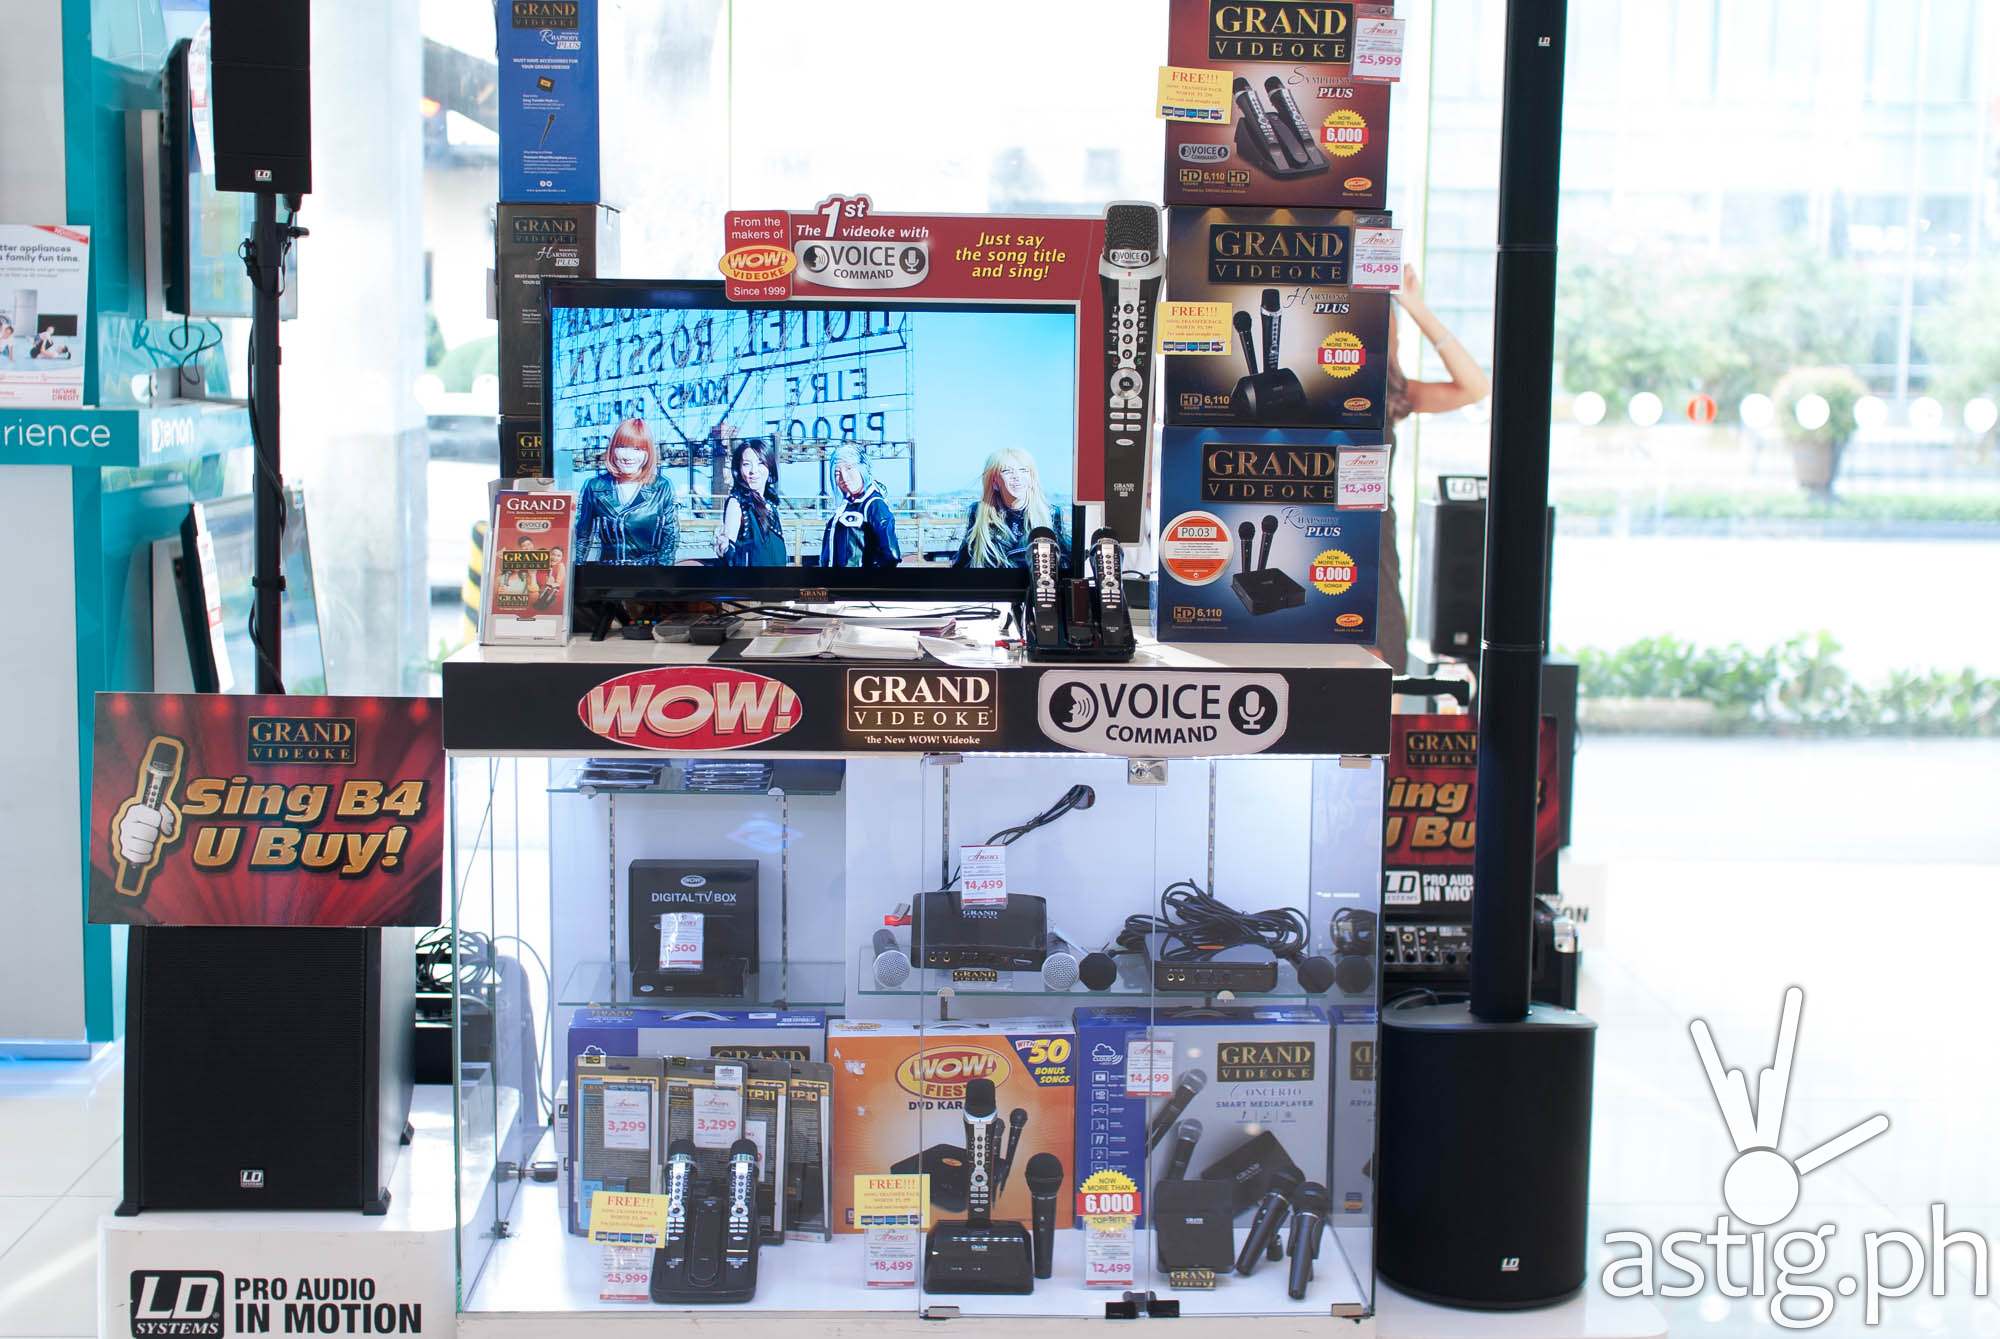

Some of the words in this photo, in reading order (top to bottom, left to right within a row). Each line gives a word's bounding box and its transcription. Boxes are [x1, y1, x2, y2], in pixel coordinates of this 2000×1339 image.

[514, 3, 577, 16] GRAND
[1216, 6, 1347, 34] GRAND
[1216, 41, 1345, 57] VIDEOKE
[1360, 55, 1401, 66] 25,999
[1172, 72, 1218, 83] FREE!!!
[1318, 87, 1354, 98] PLUS
[1326, 128, 1363, 142] 6,000
[1191, 146, 1217, 155] VOICE
[1181, 170, 1200, 181] HD
[1203, 172, 1225, 182] 6,110
[1229, 171, 1248, 182] HD
[734, 218, 760, 227] From
[764, 218, 781, 227] the
[821, 200, 866, 238] 1st
[514, 219, 576, 232] GRAND
[796, 224, 821, 236] The
[900, 225, 929, 238] with
[732, 231, 770, 239] makers
[774, 230, 783, 239] of
[842, 226, 895, 238] videoke
[976, 232, 1011, 247] Just
[1017, 234, 1045, 249] say
[1216, 231, 1343, 257] GRAND
[19, 244, 71, 254] appliances
[6, 253, 36, 262] family
[38, 253, 54, 262] fun
[728, 250, 787, 269] WOW!
[830, 246, 896, 266] VOICE
[955, 248, 981, 261] the
[988, 251, 1027, 265] song
[1033, 249, 1066, 262] title
[1120, 252, 1140, 260] VOICE
[732, 268, 786, 280] VIDEOKE
[833, 268, 893, 280] COMMAND
[972, 264, 1003, 277] and
[1008, 264, 1049, 281] sing!
[1216, 264, 1341, 279] VIDEOKE
[1362, 264, 1398, 273] 18,499
[734, 286, 760, 296] Since
[763, 286, 786, 296] 1999
[1172, 306, 1217, 316] FREE!!!
[1315, 303, 1349, 313] PLUS
[1324, 349, 1359, 364] 6,000
[1204, 396, 1230, 405] 6,110
[4, 418, 111, 448] rience
[1208, 450, 1335, 477] GRAND
[1208, 483, 1334, 499] VIDEOKE
[1344, 484, 1381, 494] 12,499
[507, 498, 565, 511] GRAND
[1307, 527, 1341, 537] PLUS
[504, 553, 549, 561] GRAND
[1315, 567, 1351, 581] 6,000
[1197, 609, 1222, 618] 6,110
[853, 676, 990, 704] GRAND
[1100, 683, 1221, 720] VOICE
[587, 681, 797, 737] WOW!
[854, 711, 990, 726] VIDEOKE
[252, 722, 351, 743] GRAND
[1105, 724, 1218, 744] COMMAND
[885, 735, 906, 744] New
[908, 735, 940, 744] WOW!
[942, 735, 981, 744] Videoke
[252, 748, 351, 759] VIDEOKE
[181, 776, 328, 823] Sing
[336, 780, 425, 816] B4
[193, 827, 240, 867] U
[251, 825, 408, 874] Buy!
[964, 880, 1003, 890] 14,499
[1423, 875, 1448, 886] PRO
[1449, 875, 1473, 886] AUD
[651, 892, 694, 902] DIGITAL
[695, 890, 713, 902] TV
[714, 893, 737, 903] BOX
[1424, 886, 1441, 901] IN
[1028, 1039, 1071, 1064] 50
[1221, 1046, 1311, 1064] GRAND
[912, 1054, 996, 1081] WOW!
[1035, 1067, 1066, 1075] BONUS
[1221, 1068, 1311, 1079] VIDEOKE
[1040, 1076, 1070, 1084] SONGS
[908, 1101, 934, 1111] DVD
[937, 1101, 963, 1110] KAR
[608, 1120, 646, 1131] 3,299
[698, 1119, 736, 1130] 3,299
[241, 1171, 262, 1183] LD
[869, 1179, 915, 1189] FREE!!!
[608, 1196, 655, 1207] FREE!!!
[1085, 1194, 1133, 1214] 6,000
[874, 1261, 912, 1271] 18,499
[1093, 1264, 1131, 1273] 12,499
[608, 1273, 648, 1284] 25,999
[1170, 1271, 1215, 1279] GRAND
[235, 1278, 287, 1301] PRO
[295, 1278, 375, 1301] AUDIO
[135, 1276, 220, 1319] LD
[235, 1303, 270, 1333] IN
[284, 1303, 421, 1333] MOTION
[136, 1322, 219, 1336] SYSTEMS
